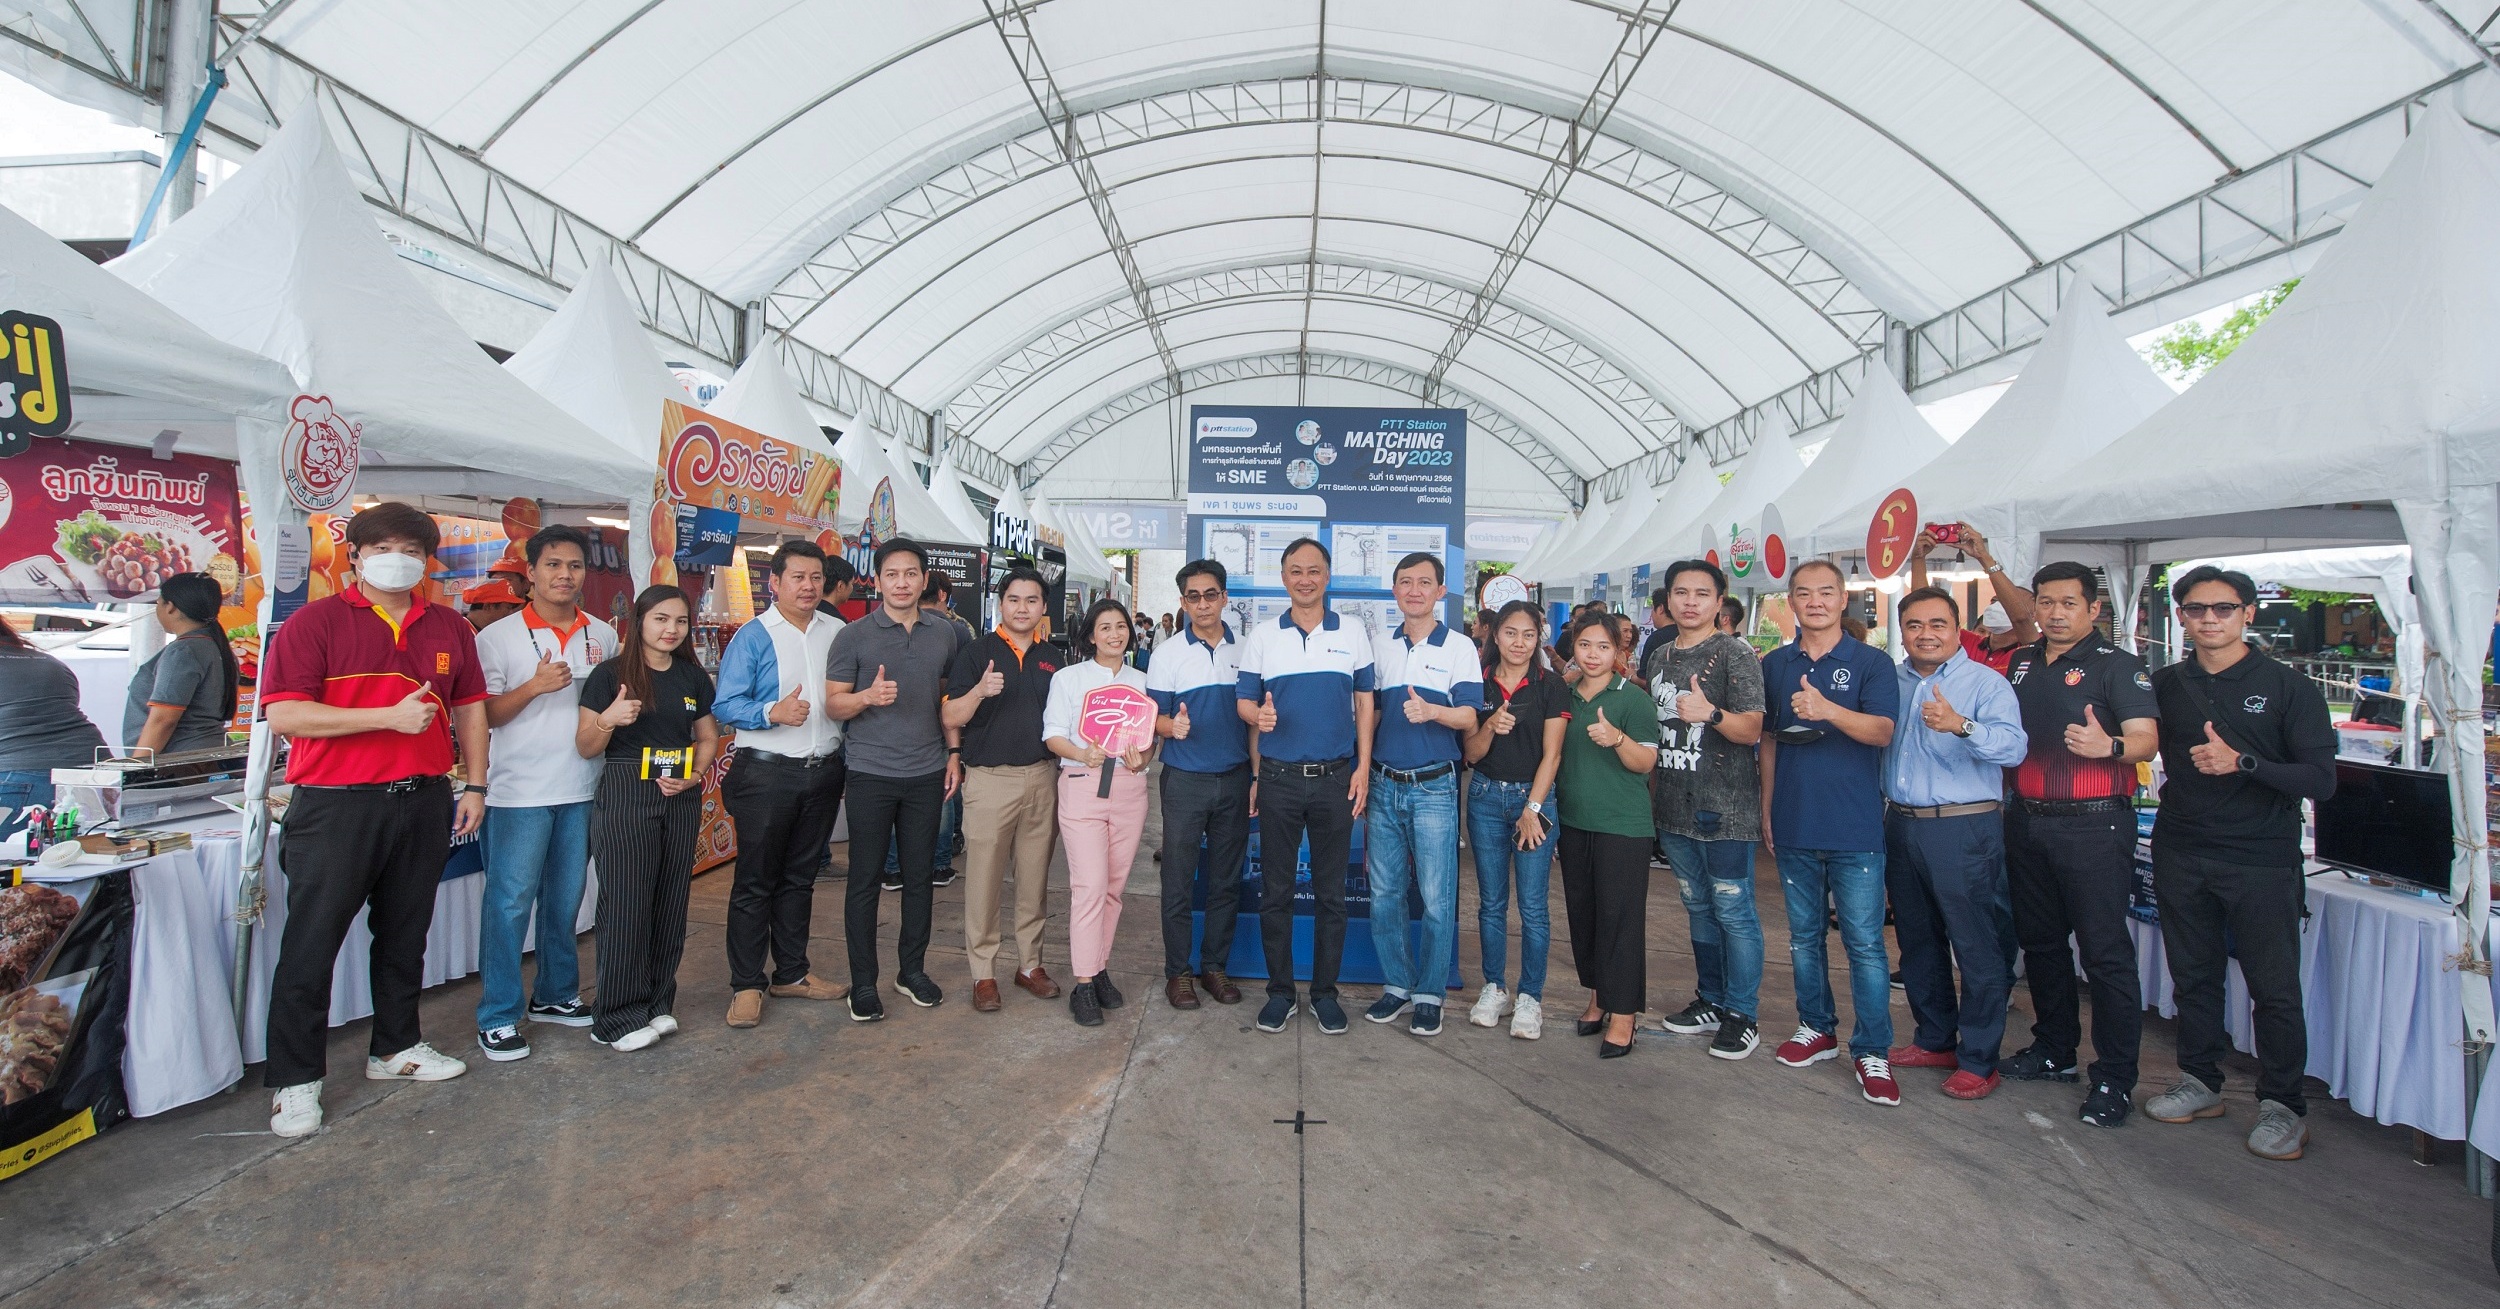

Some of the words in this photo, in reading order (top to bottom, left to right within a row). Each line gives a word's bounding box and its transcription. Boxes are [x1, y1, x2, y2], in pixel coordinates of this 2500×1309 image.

[1380, 420, 1404, 429] PTT
[1406, 420, 1447, 430] Station
[1344, 431, 1445, 449] MATCHING
[666, 421, 814, 500] วรารัตน์
[1373, 448, 1408, 468] Day
[1407, 450, 1453, 465] 2023
[41, 455, 209, 506] ลูกชิ้นทิพย์
[1228, 469, 1267, 484] SME
[1368, 471, 1384, 481] วันที่
[1434, 474, 1453, 482] 2566
[1202, 501, 1219, 509] เขต
[1223, 500, 1228, 509] 1
[1232, 501, 1261, 512] ชุมพร
[1267, 501, 1298, 511] ระนอง
[701, 529, 733, 545] วรารัตน์
[994, 511, 1007, 549] Hi
[938, 557, 967, 568] SMALL
[2011, 670, 2029, 685] 37
